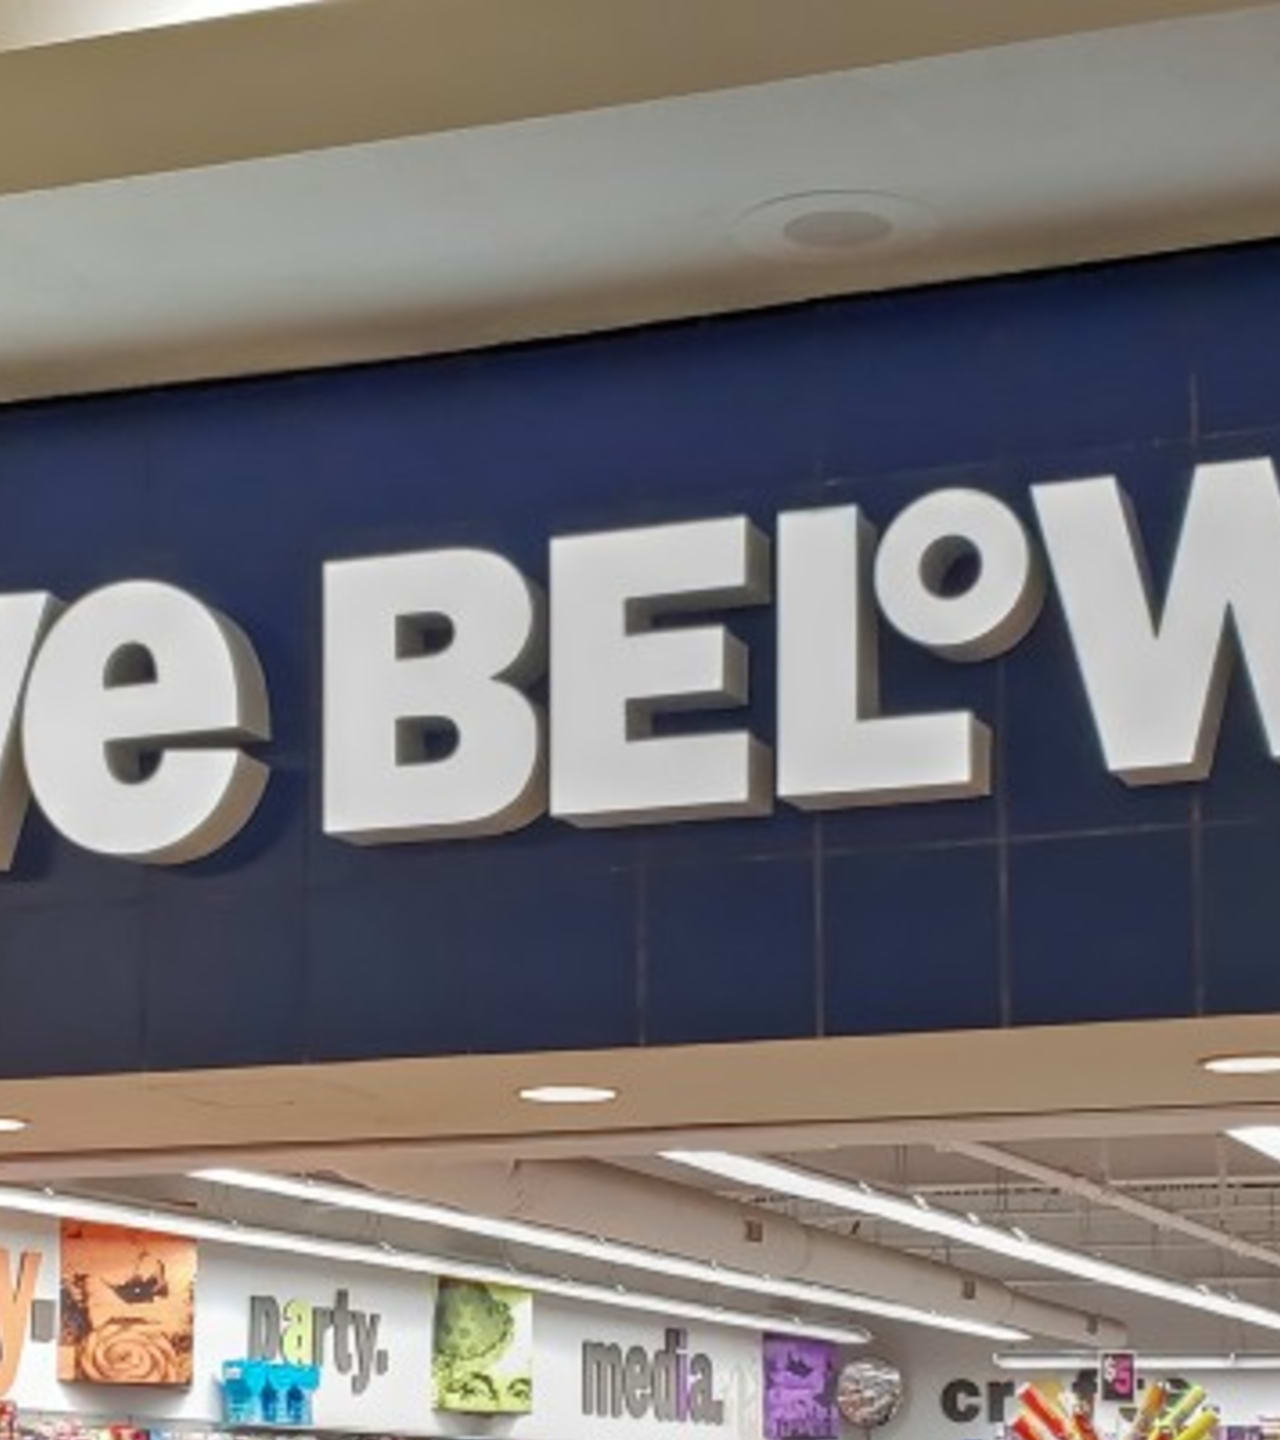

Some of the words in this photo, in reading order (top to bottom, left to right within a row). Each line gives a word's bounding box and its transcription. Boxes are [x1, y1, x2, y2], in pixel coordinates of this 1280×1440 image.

[248, 1290, 389, 1396] party.
[580, 1327, 724, 1426] media.
[1104, 1354, 1133, 1395] $5
